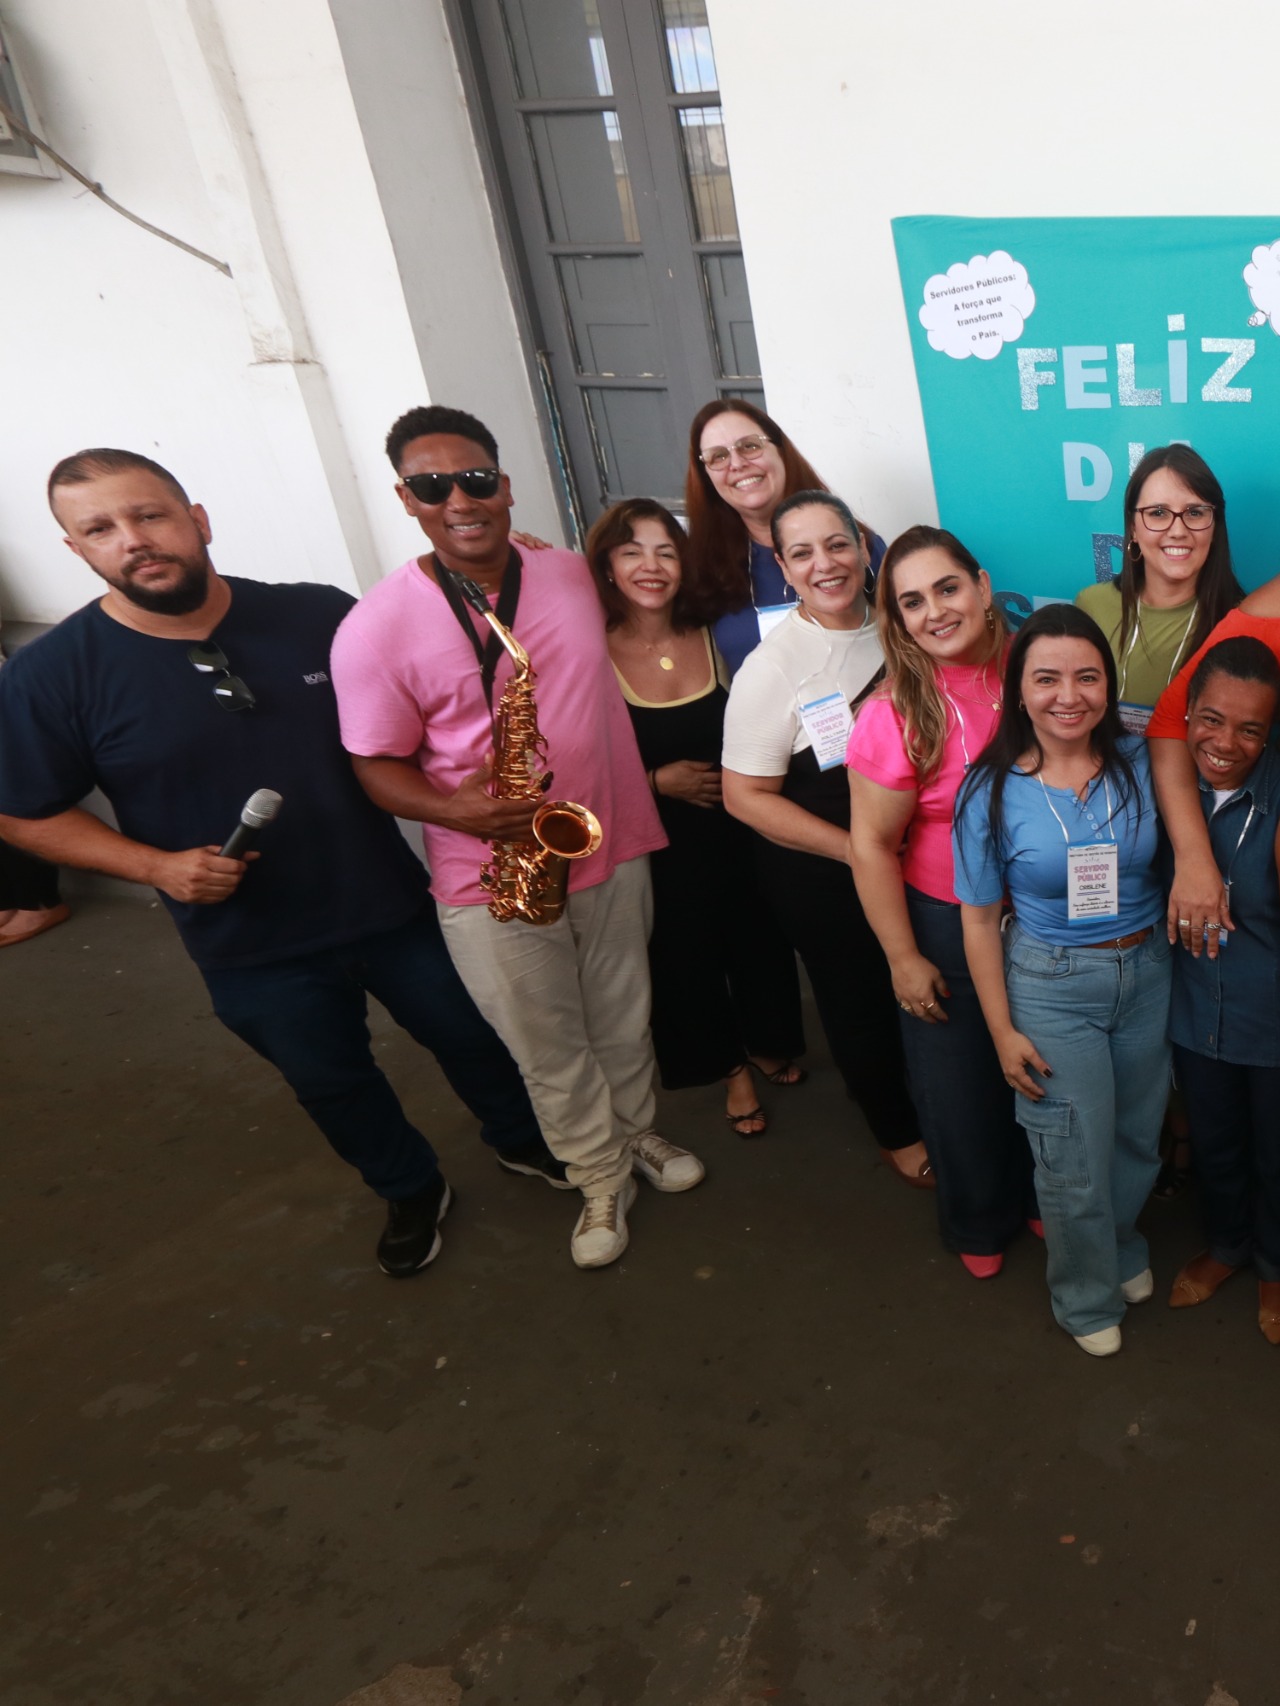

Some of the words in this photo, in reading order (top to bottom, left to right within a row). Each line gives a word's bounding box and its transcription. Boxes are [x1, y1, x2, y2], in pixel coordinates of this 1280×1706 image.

[930, 283, 975, 300] Servidores
[976, 274, 1017, 290] Públicos:
[953, 304, 960, 312] A
[961, 299, 984, 309] força
[986, 295, 1002, 305] que
[957, 311, 1003, 328] transforma
[811, 712, 844, 729] SERVIDOR
[1074, 863, 1110, 874] SERVIDOR
[1077, 873, 1107, 883] PÚBLICO
